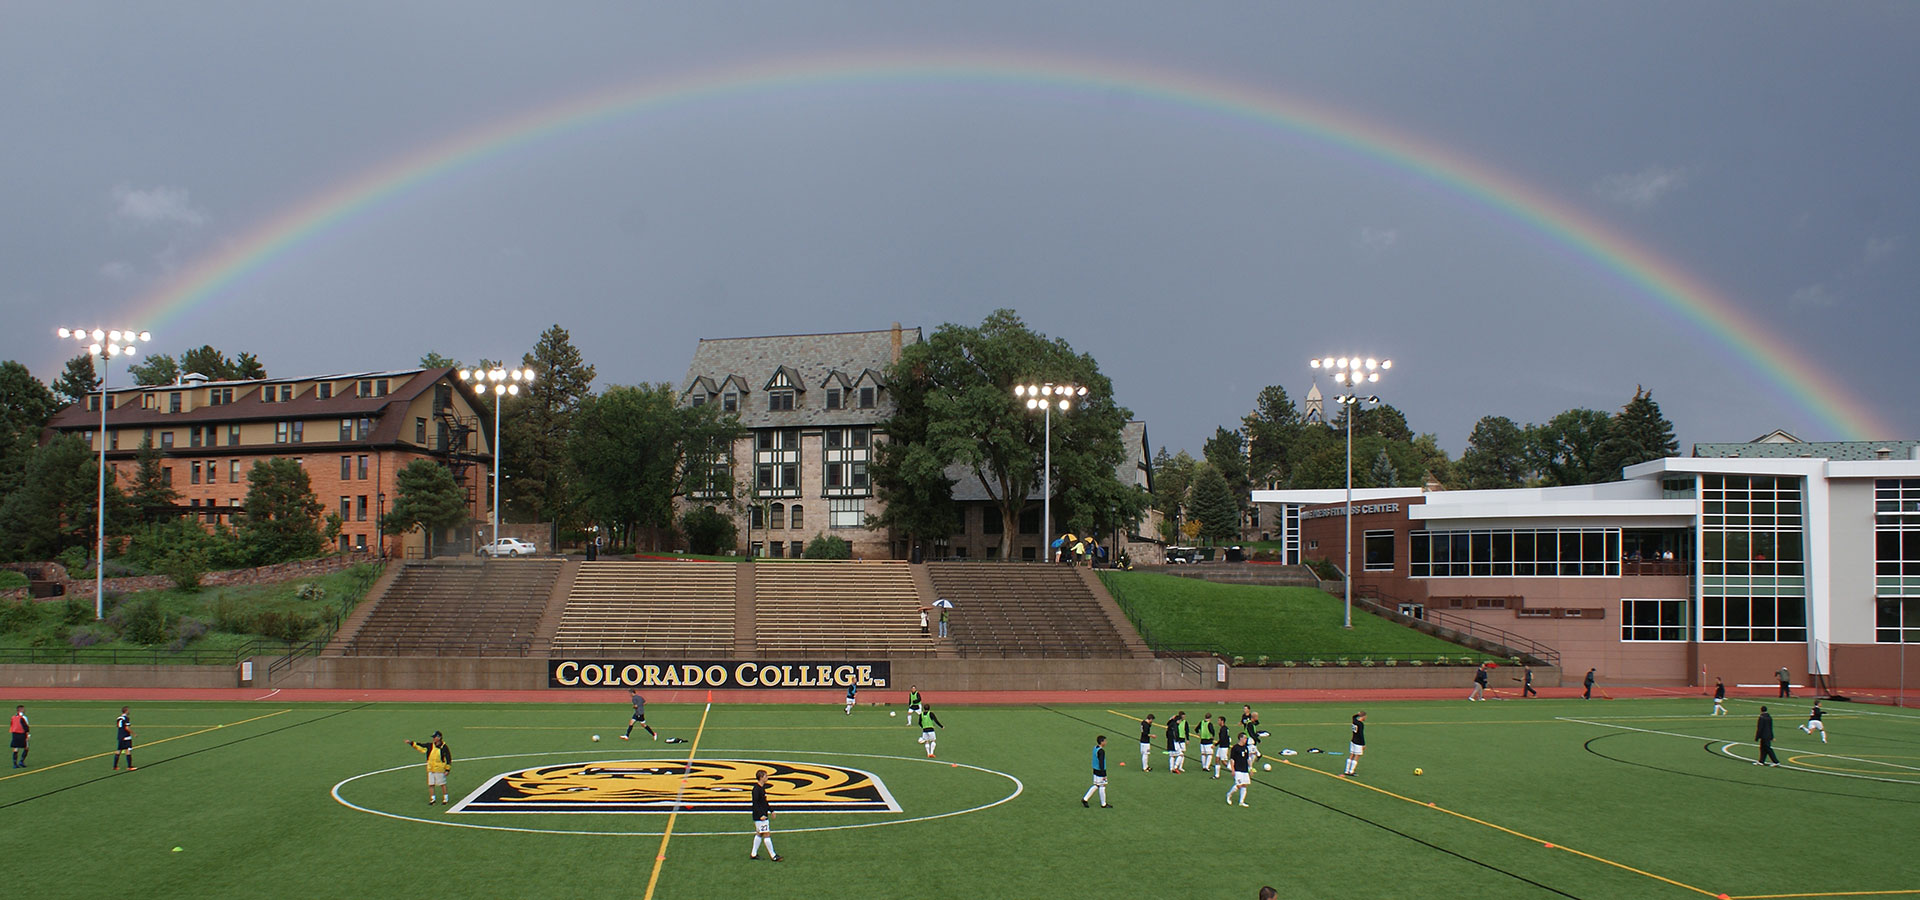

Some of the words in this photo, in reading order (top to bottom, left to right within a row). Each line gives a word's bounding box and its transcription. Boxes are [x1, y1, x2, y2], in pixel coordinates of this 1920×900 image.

[1330, 505, 1361, 516] FITNSS
[1362, 503, 1400, 514] CENTER
[555, 661, 728, 686] COLORADO
[734, 661, 874, 686] COLLEGE
